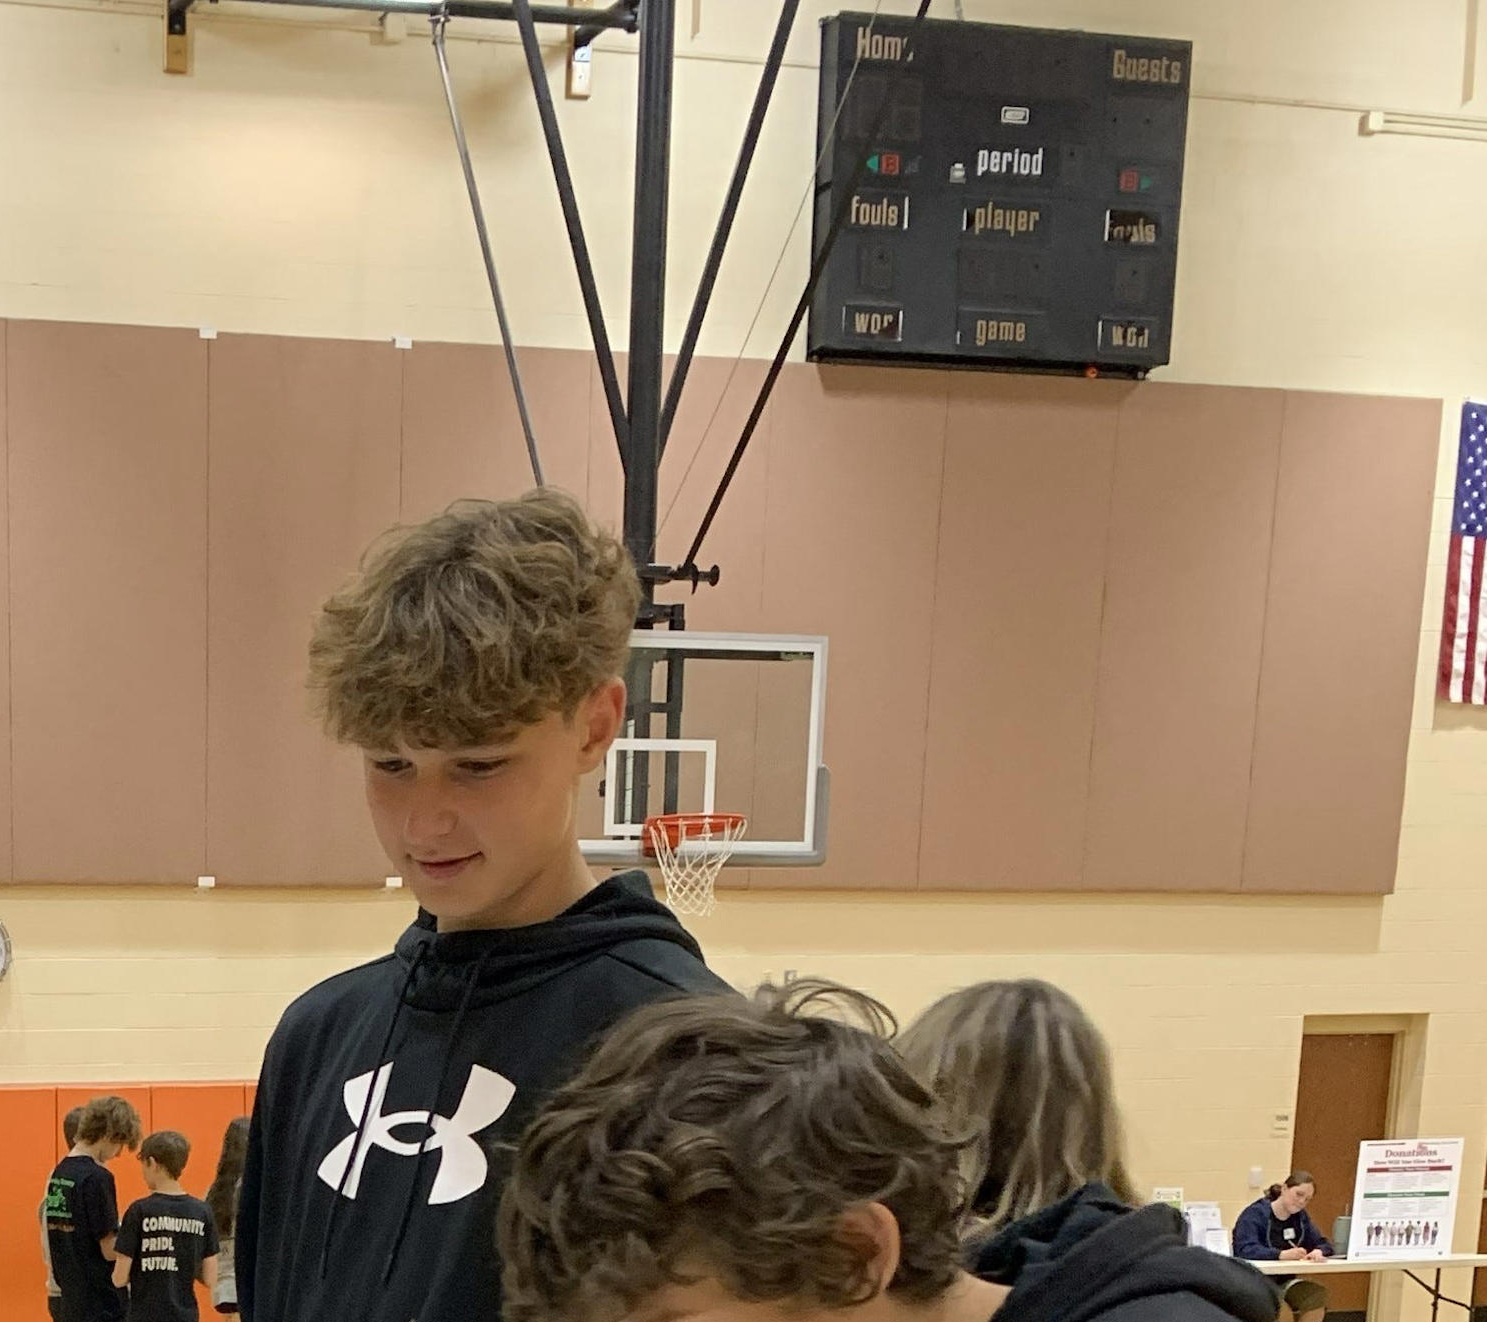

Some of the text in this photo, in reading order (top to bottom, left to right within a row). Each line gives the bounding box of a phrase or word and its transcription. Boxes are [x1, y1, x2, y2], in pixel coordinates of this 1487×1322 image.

[1112, 49, 1182, 84] Guests
[977, 147, 1044, 176] period
[850, 195, 899, 227] fouls
[974, 201, 1040, 237] player
[975, 319, 1026, 346] game
